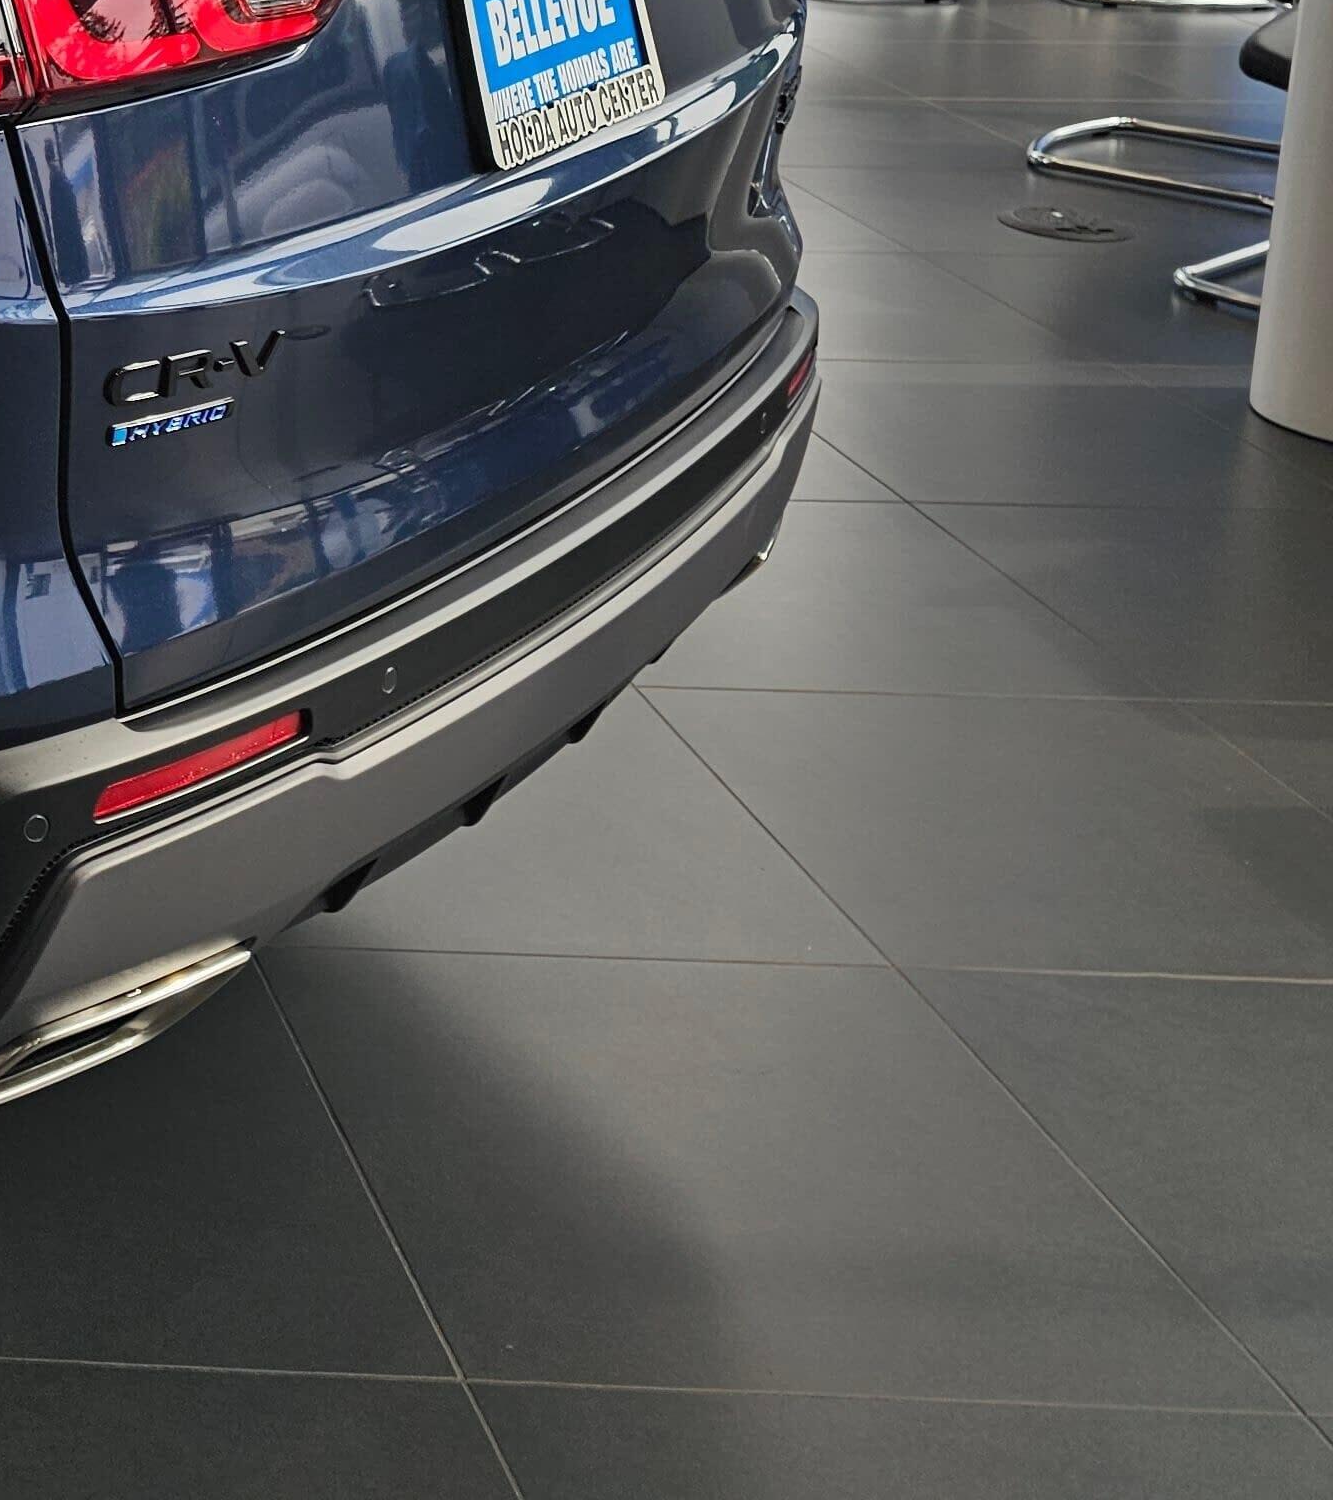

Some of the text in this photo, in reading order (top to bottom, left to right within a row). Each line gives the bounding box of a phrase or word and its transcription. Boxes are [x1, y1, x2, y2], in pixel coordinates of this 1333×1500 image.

[491, 37, 639, 122] WHERE THE HONDAS ARE
[496, 68, 660, 167] HONDA AUTO CENTER
[102, 328, 286, 407] CR-V
[127, 404, 229, 442] HYBRID
